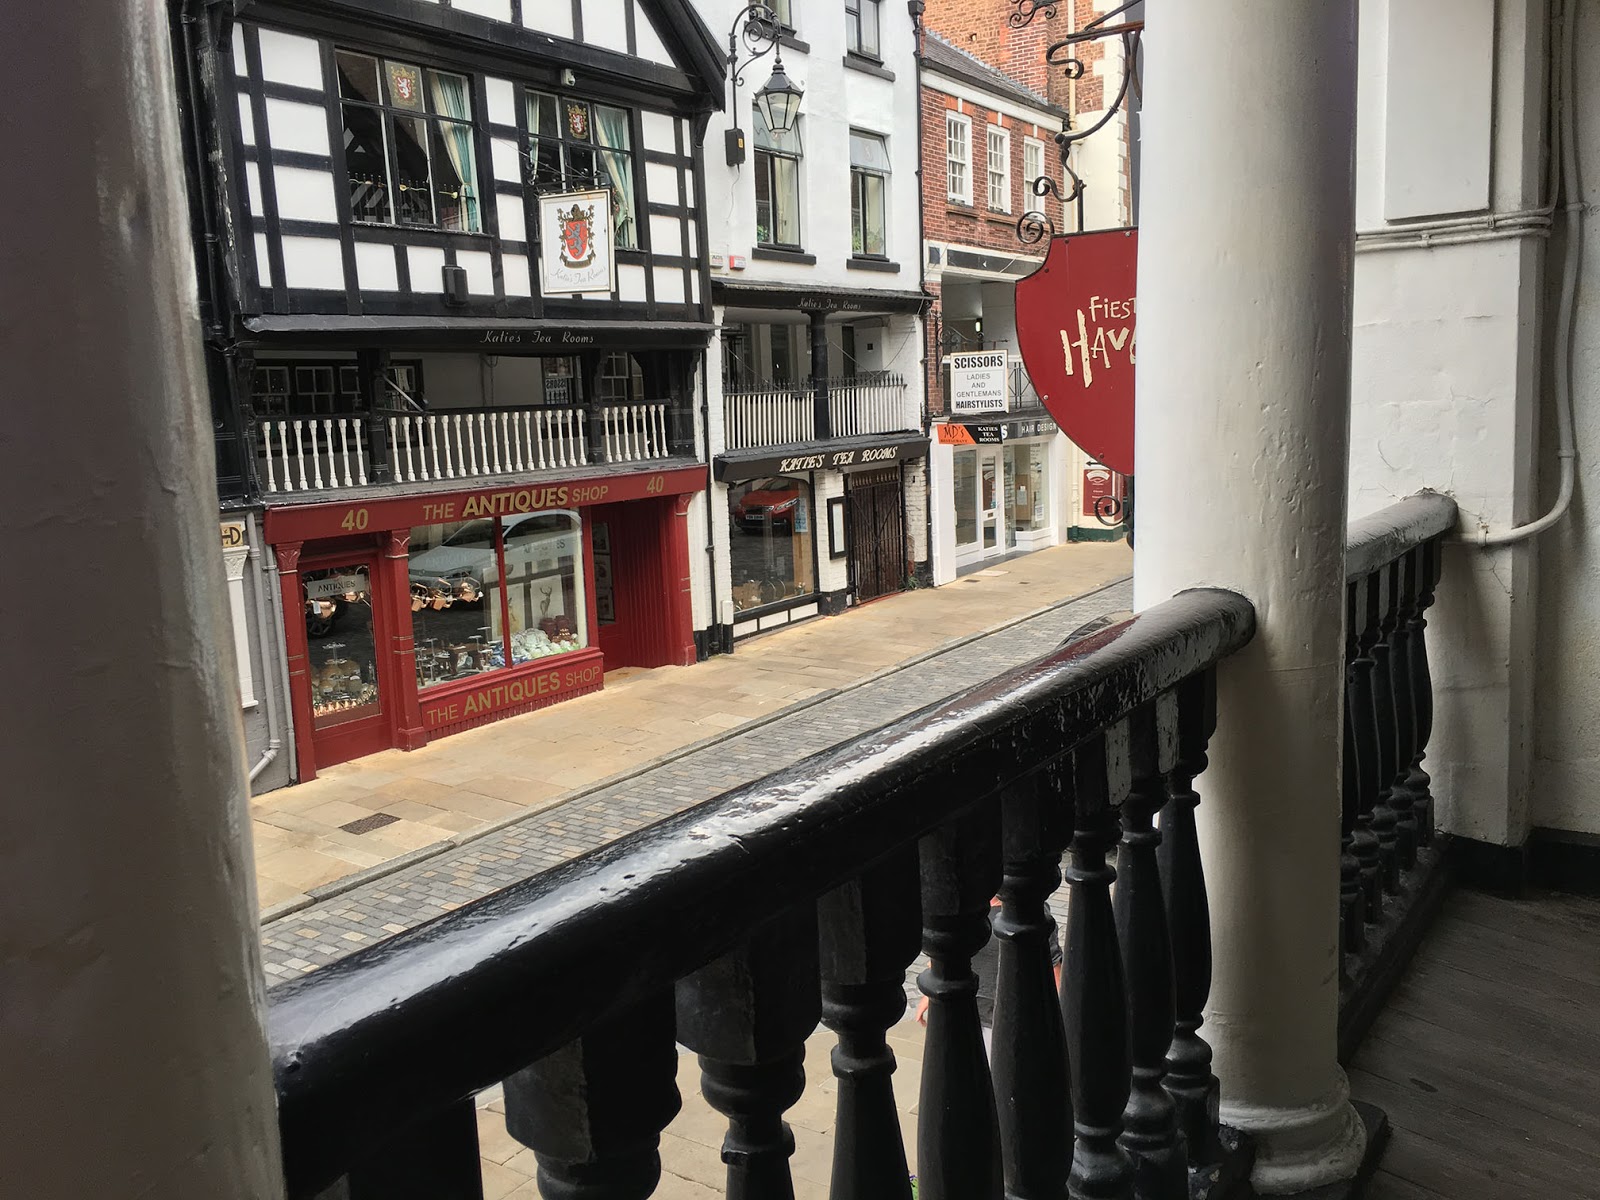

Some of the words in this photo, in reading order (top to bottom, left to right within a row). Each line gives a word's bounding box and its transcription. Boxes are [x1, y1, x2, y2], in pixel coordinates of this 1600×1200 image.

[480, 330, 521, 343] Katie's
[532, 331, 552, 344] Tea
[562, 331, 594, 344] Rooms
[954, 355, 1003, 369] SCISSORS
[956, 390, 1002, 398] GENTLEMANS
[955, 399, 1003, 409] HAIRSTYLISTS
[1021, 425, 1034, 434] HAIR
[779, 454, 825, 472] KATIE'S
[832, 451, 855, 465] TEA
[861, 446, 898, 462] ROOMS
[341, 508, 369, 531] 40
[423, 502, 455, 521] THE
[462, 486, 568, 518] ANTIQUES
[571, 485, 609, 503] SHOP
[646, 475, 664, 494] 40
[427, 704, 459, 725] THE
[464, 671, 561, 716] ANTIQUES
[565, 665, 601, 687] SHOP
